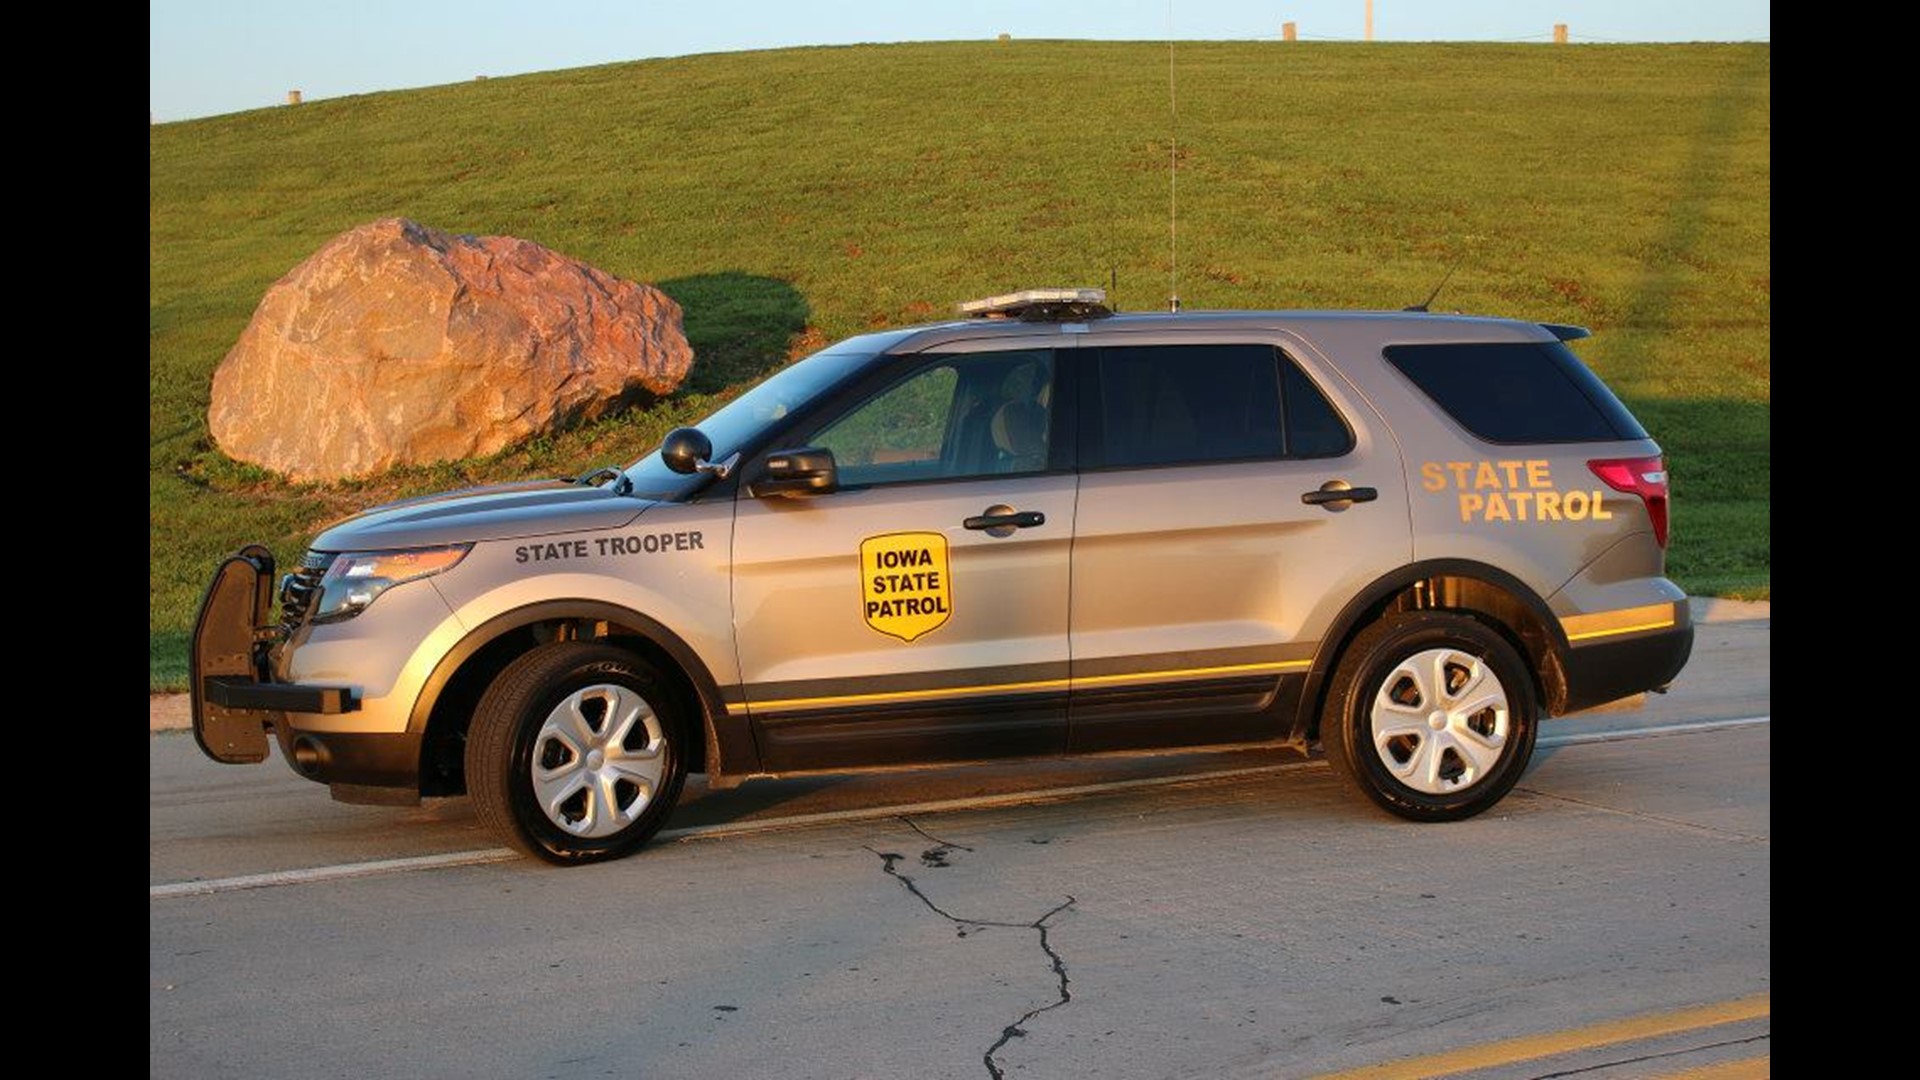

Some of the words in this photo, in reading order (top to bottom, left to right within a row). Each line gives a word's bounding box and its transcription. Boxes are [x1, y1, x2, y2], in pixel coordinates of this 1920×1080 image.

[1421, 460, 1552, 492] STATE
[1459, 490, 1612, 522] PATROL
[515, 540, 588, 563] STATE
[595, 531, 704, 555] TROOPER
[877, 549, 932, 569] IOWA
[873, 572, 940, 593] STATE
[867, 596, 947, 618] PATROL
